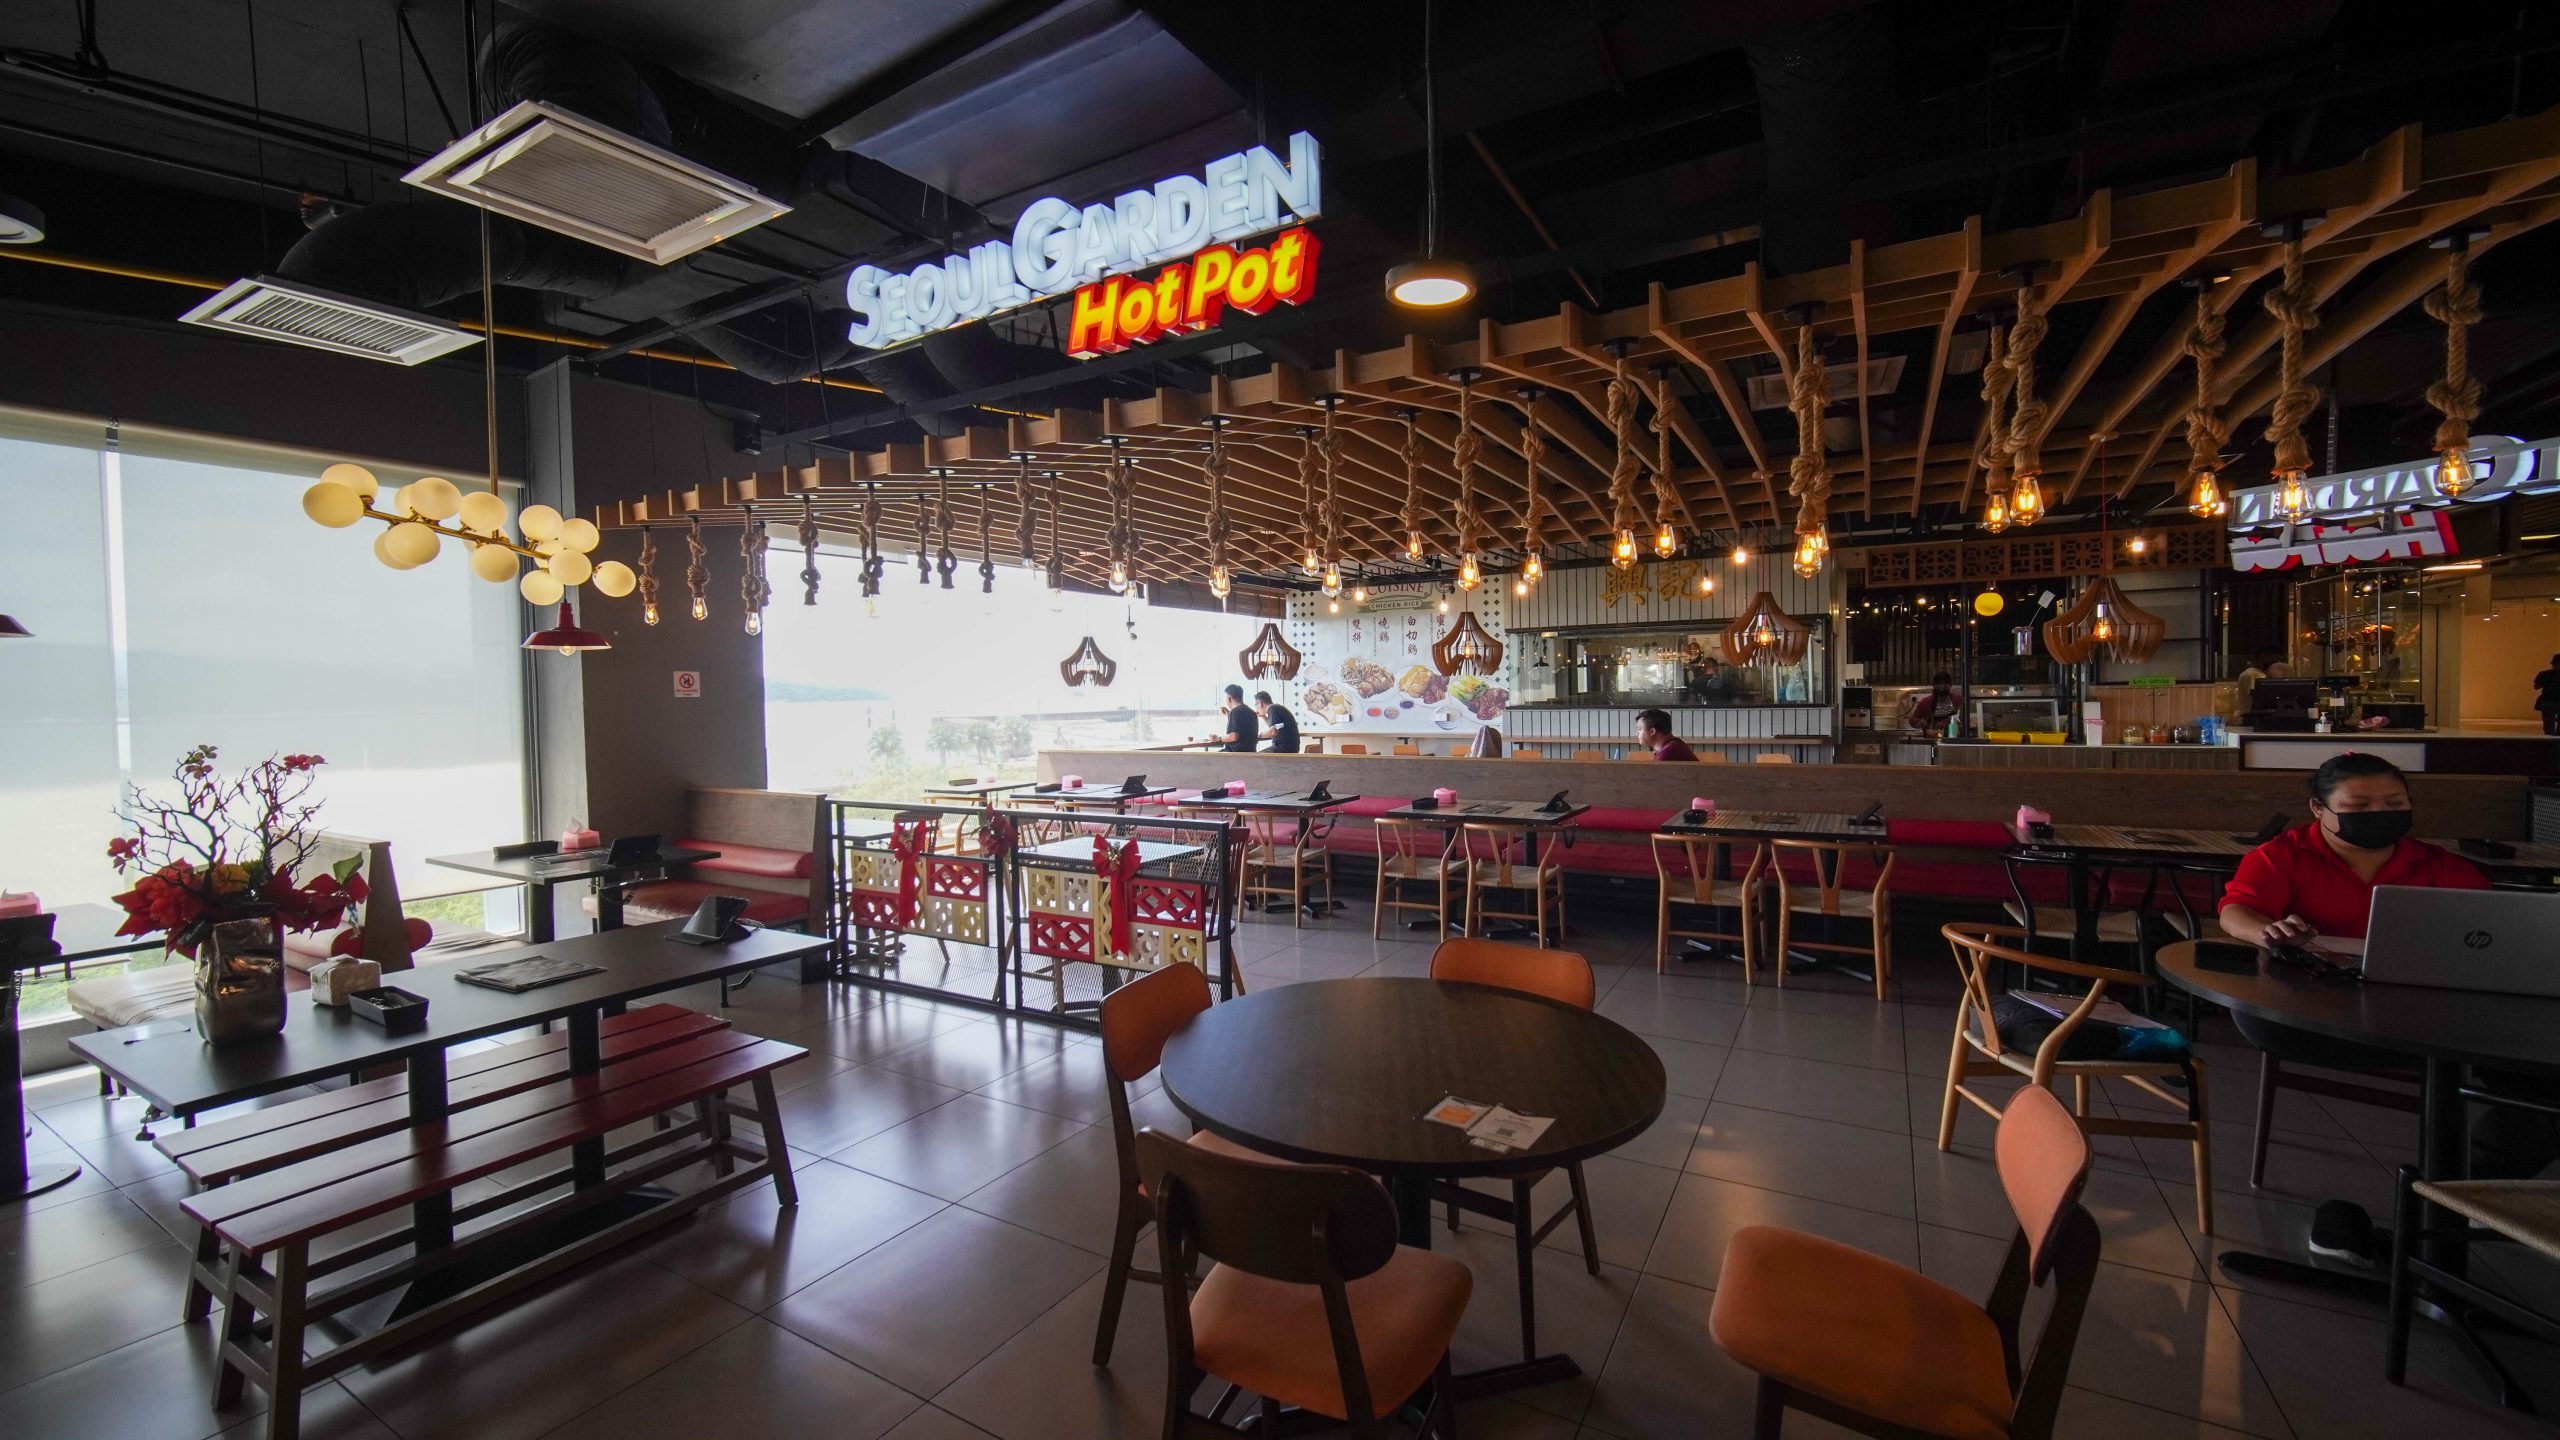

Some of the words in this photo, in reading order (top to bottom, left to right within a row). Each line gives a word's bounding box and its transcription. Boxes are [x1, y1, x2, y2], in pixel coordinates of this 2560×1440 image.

[847, 264, 1032, 350] SEOUL
[1012, 130, 1322, 296] GARDEN
[1068, 262, 1191, 359] Hot
[1184, 226, 1321, 329] Pot
[1366, 581, 1425, 596] CUISINE
[1370, 602, 1401, 610] CHICKEN
[2466, 929, 2491, 949] hp
